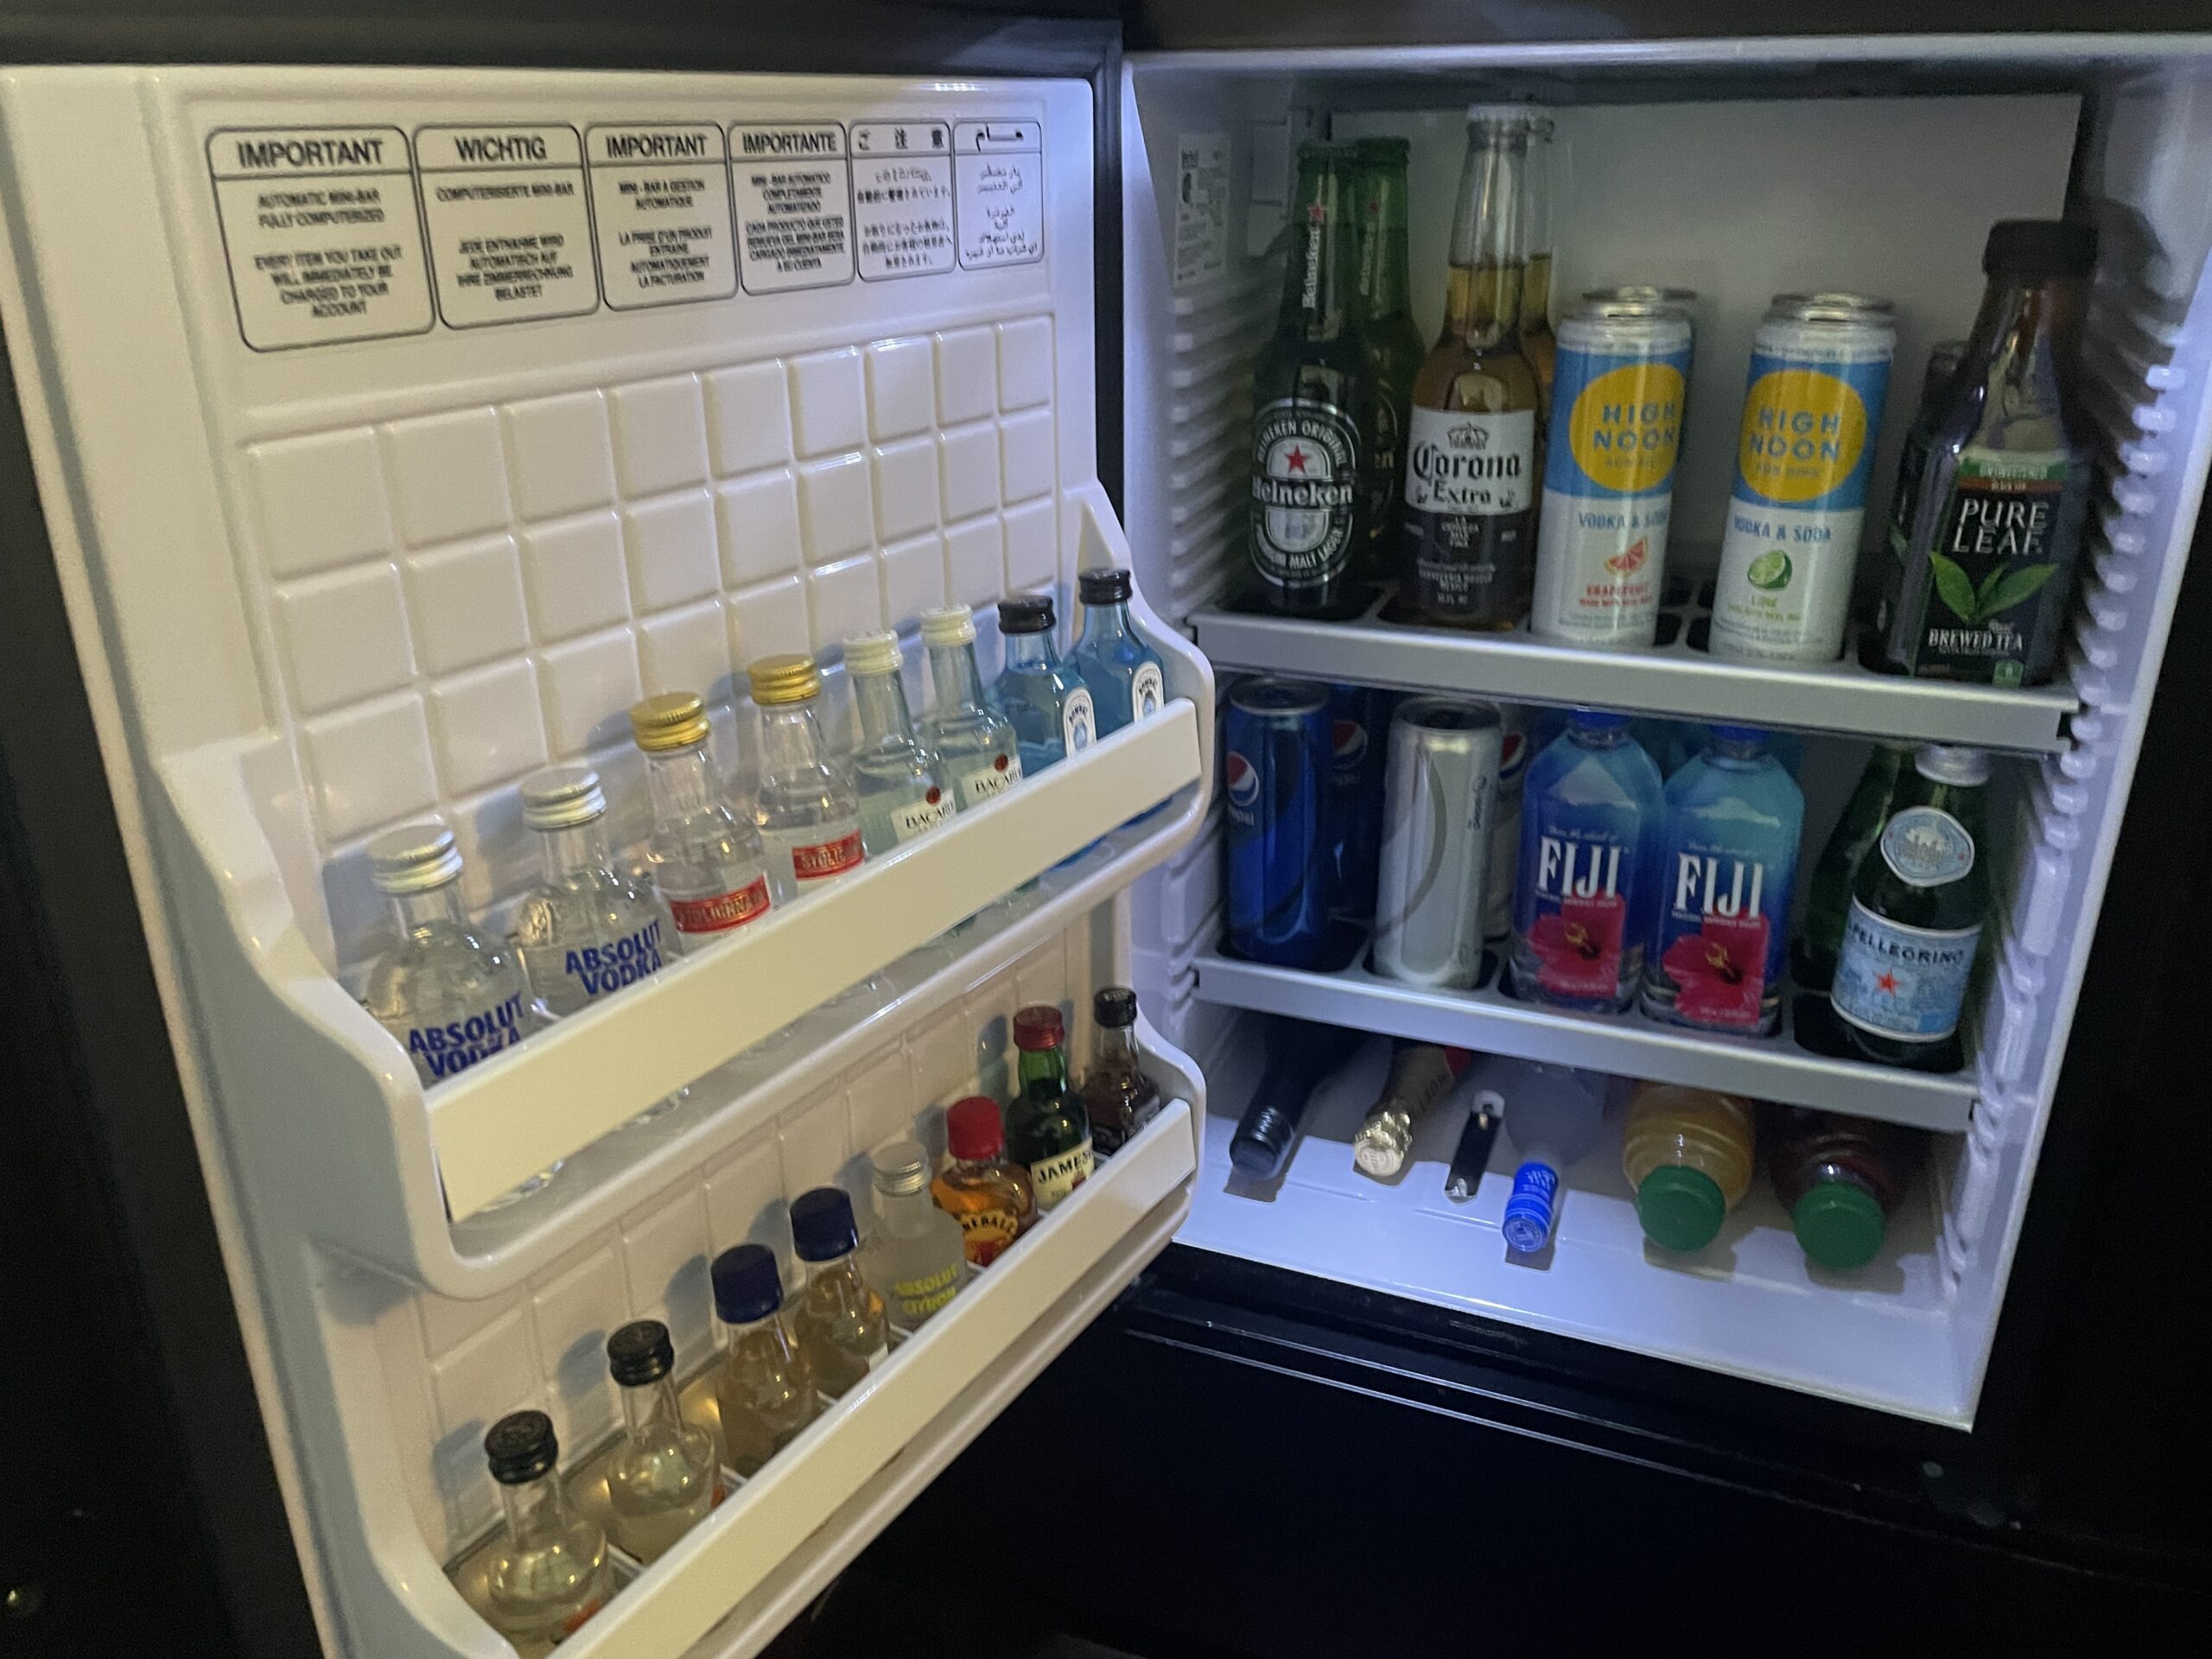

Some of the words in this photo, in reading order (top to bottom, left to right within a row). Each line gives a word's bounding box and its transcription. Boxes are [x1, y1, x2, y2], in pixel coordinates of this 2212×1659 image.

[236, 137, 383, 168] IMPORTANT
[454, 136, 548, 162] WICHTIG
[606, 133, 708, 158] IMPORTANT
[742, 130, 837, 154] IMPORTANTE
[1603, 401, 1675, 425] HIGH
[1758, 405, 1840, 434] HIGH
[1592, 427, 1675, 452] NOON
[1749, 431, 1840, 463] NOON
[1413, 441, 1521, 483] Corona
[1253, 476, 1354, 507] Heineken
[1433, 480, 1491, 505] Extra
[1578, 511, 1625, 530] VODKA
[1960, 498, 2050, 529] PURE
[1792, 524, 1832, 543] SODA
[1951, 524, 2044, 556] LEAF
[1288, 552, 1318, 570] MALT
[1928, 628, 1993, 650] BREWED
[1996, 632, 2023, 652] TEA
[1537, 835, 1622, 899] FIJI
[1673, 851, 1764, 920] FIJI
[565, 918, 662, 975] ABSOLUT
[578, 953, 664, 995] VODKA
[409, 990, 525, 1056] ABSOLUT
[893, 1262, 958, 1296] ABSOLUT
